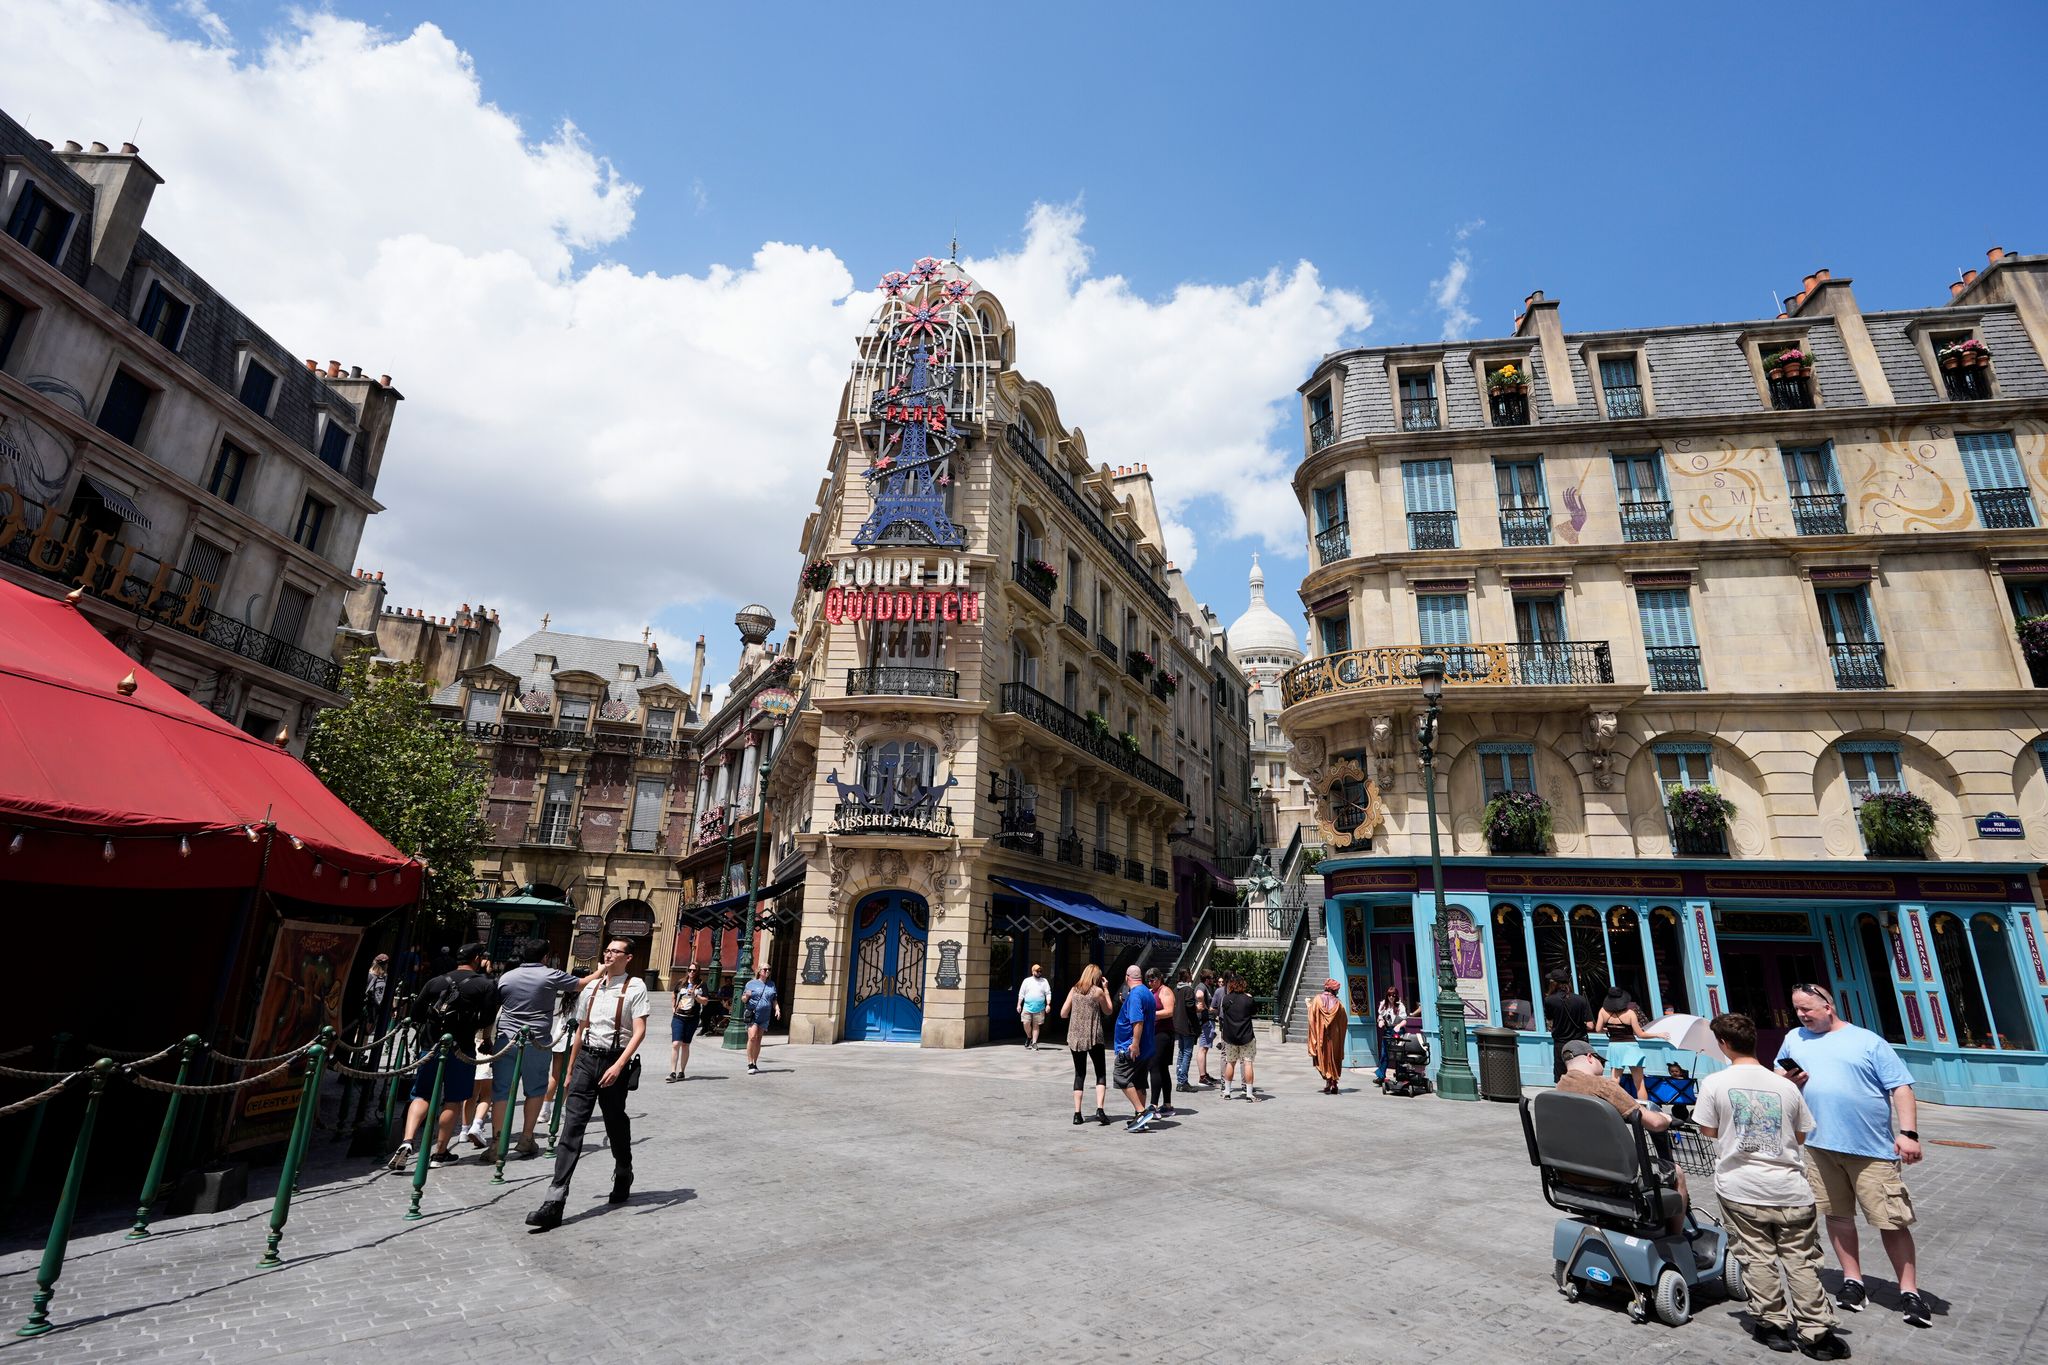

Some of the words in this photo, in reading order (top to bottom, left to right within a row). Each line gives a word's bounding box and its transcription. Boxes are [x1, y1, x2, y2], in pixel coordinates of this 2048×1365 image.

[887, 404, 946, 423] PARIS
[837, 557, 926, 588] COUPE
[937, 557, 971, 587] DE
[824, 587, 980, 625] QUIDDITCH
[1945, 883, 1977, 892] PARIS
[2024, 925, 2042, 973] MATAGOT
